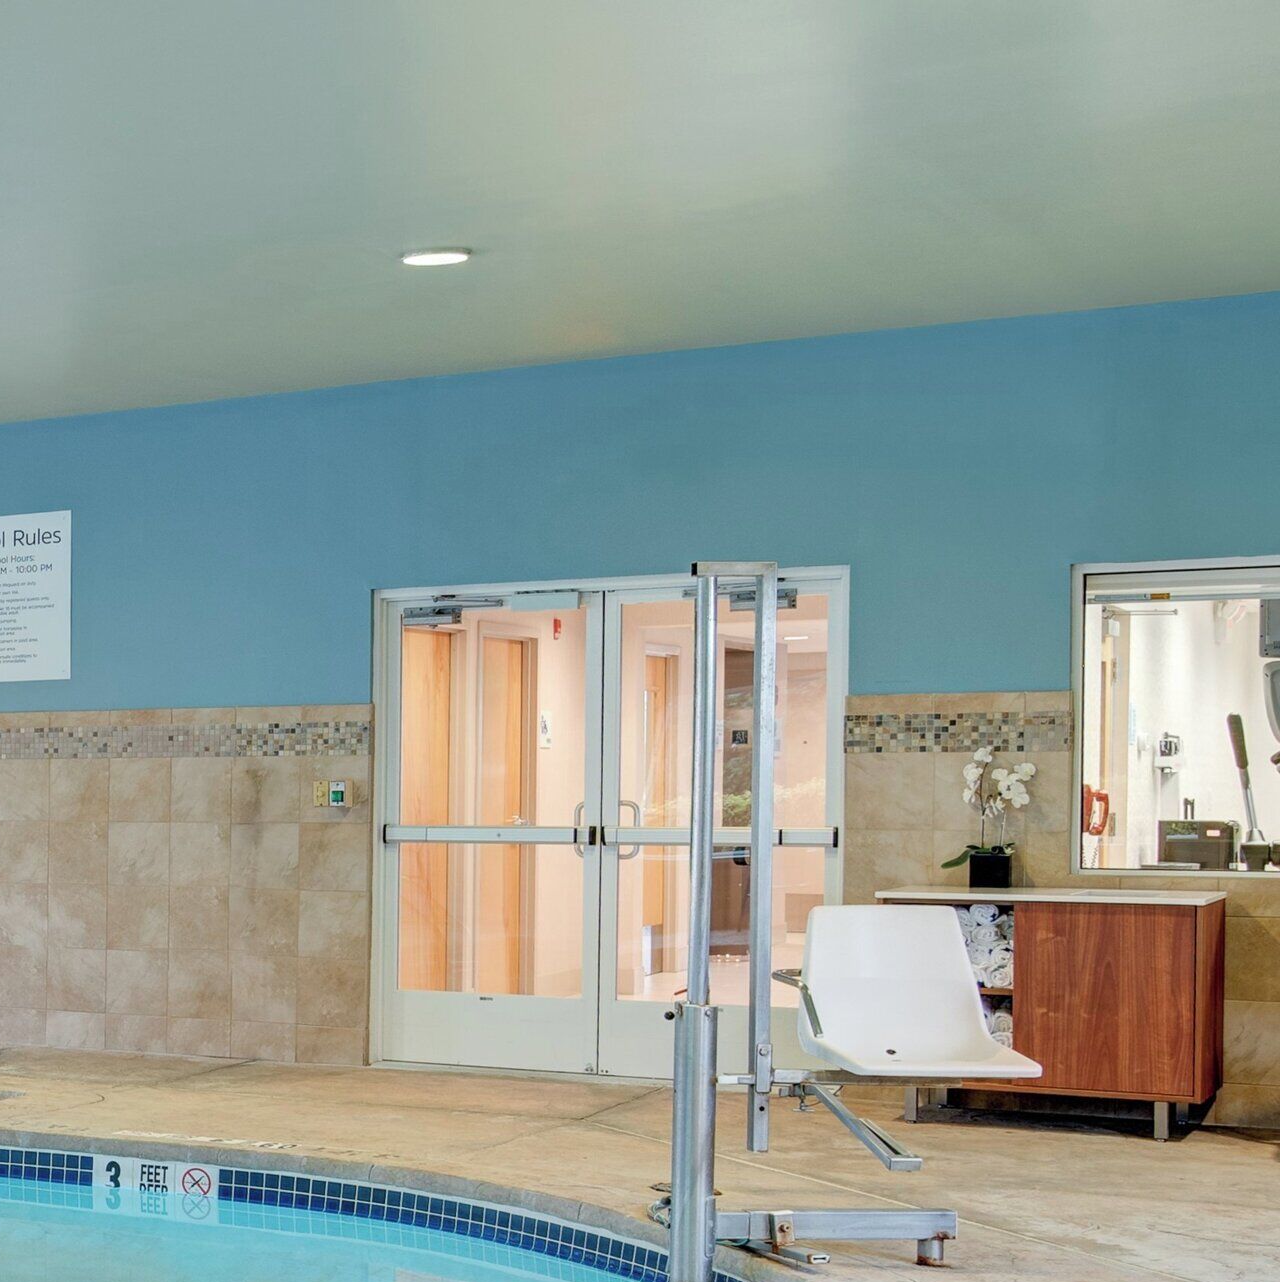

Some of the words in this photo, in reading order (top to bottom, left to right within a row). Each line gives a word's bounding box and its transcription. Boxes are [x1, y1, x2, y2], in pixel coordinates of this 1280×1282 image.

[14, 528, 61, 546] Rules
[16, 565, 38, 573] 10:00
[105, 1161, 121, 1187] 3
[140, 1164, 168, 1184] FEET
